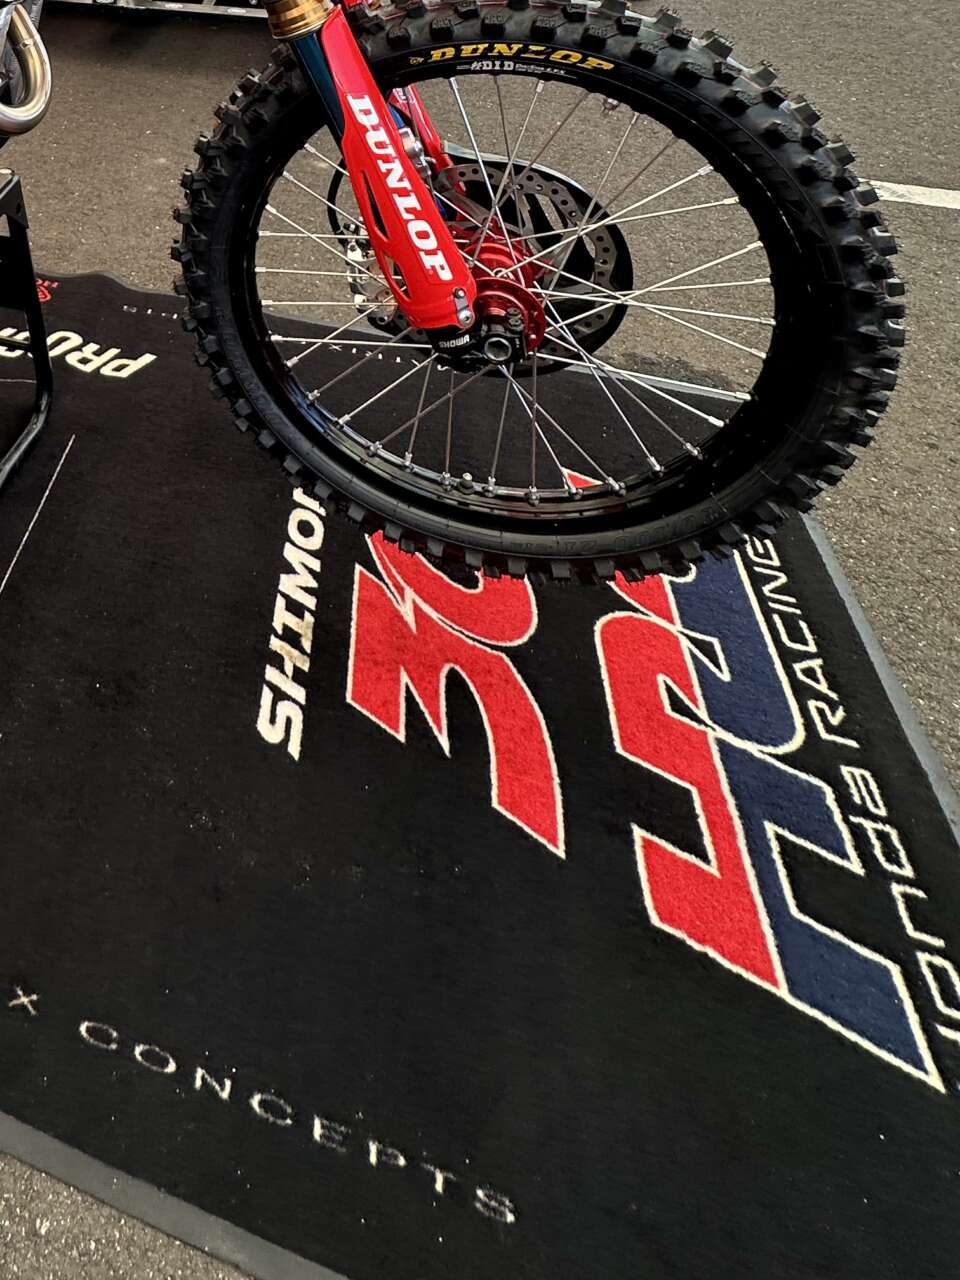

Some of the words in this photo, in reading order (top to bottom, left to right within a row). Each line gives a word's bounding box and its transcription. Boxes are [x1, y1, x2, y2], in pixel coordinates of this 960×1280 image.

[429, 43, 616, 71] DUNLOP
[346, 94, 454, 282] DUNLOP
[78, 1020, 517, 1224] CONCEPTS
